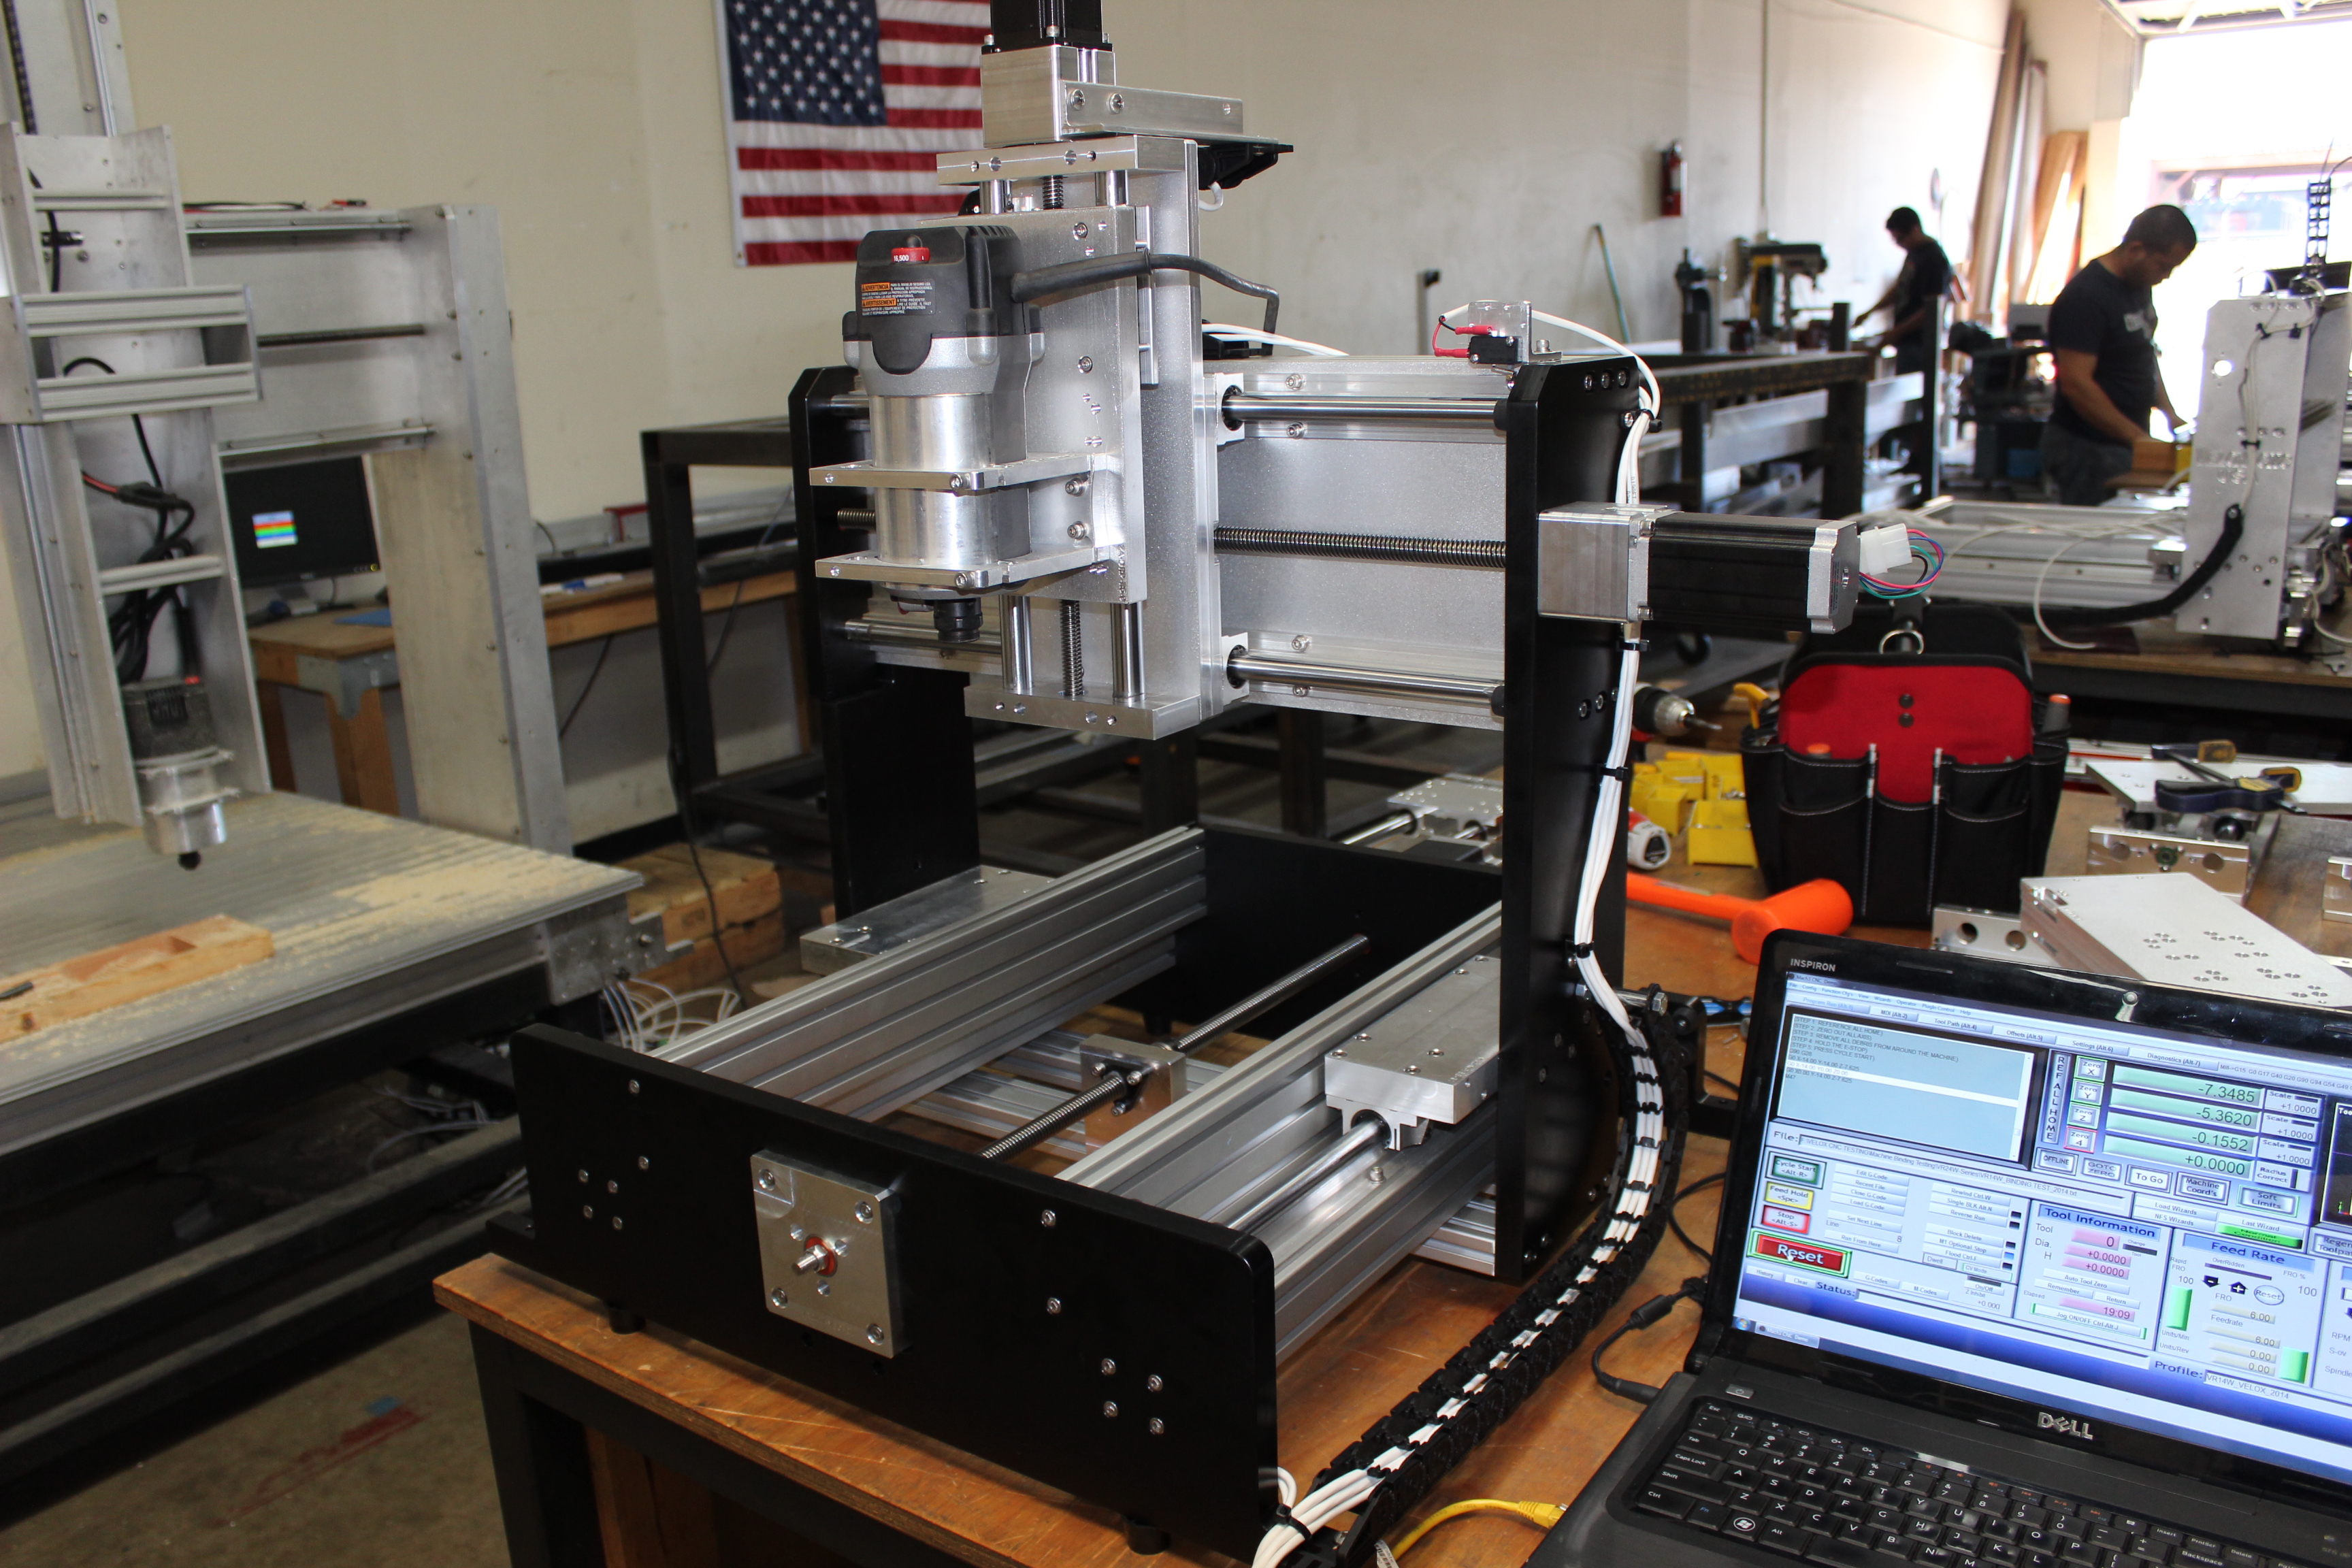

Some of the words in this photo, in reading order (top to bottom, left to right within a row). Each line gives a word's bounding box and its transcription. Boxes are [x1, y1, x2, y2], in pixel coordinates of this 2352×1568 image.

[1790, 958, 1836, 972] INSPIRON
[1802, 984, 1817, 992] Config
[1896, 999, 1916, 1007] Operator
[1803, 997, 1825, 1007] Program
[1892, 1011, 1908, 1019] (Alt-2)
[1816, 1026, 1832, 1034] ZERO
[1818, 1020, 1852, 1030] REFERENCE
[1961, 1022, 1977, 1031] (Alt-4)
[2006, 1030, 2025, 1038] Offsets
[2027, 1032, 2043, 1041] (Alt-5)
[1816, 1033, 1839, 1043] REMOVE
[1874, 1043, 1891, 1051] FROM
[1892, 1045, 1916, 1055] AROUND
[1931, 1052, 1959, 1063] MACHINE)
[2072, 1041, 2095, 1049] Settings
[2096, 1044, 2114, 1054] (Alt-6)
[1814, 1047, 1833, 1055] PRESS
[1833, 1049, 1853, 1058] CYCLE
[1854, 1052, 1876, 1062] START)
[2147, 1053, 2182, 1063] Diagnostics
[2183, 1058, 2201, 1067] (Alt-7)
[2198, 1083, 2255, 1102] -7.3485
[2269, 1091, 2292, 1100] Scale
[2074, 1108, 2093, 1116] Zero
[2281, 1103, 2317, 1115] +1.0000
[2196, 1107, 2253, 1126] -5.3620
[2266, 1115, 2288, 1123] Scale
[1774, 1131, 1798, 1142] File:
[2277, 1128, 2313, 1141] +1.0000
[2192, 1131, 2249, 1152] -0.1552
[2262, 1139, 2285, 1148] Scale
[1893, 1156, 1914, 1166] Binding
[2043, 1154, 2069, 1165] OFFLINE
[2185, 1155, 2245, 1175] +0.0000
[2276, 1154, 2310, 1165] +1.0000
[1775, 1160, 1796, 1169] Cycle
[1798, 1164, 1816, 1173] Start
[2260, 1166, 2287, 1176] Radius
[1781, 1169, 1808, 1178] <Alt-R>
[1868, 1172, 1888, 1180] G-Code
[2087, 1169, 2115, 1178] ZERO
[2257, 1173, 2288, 1183] Correct
[1855, 1179, 1874, 1188] Recent
[2150, 1176, 2163, 1184] Go
[2186, 1177, 2220, 1190] Machine
[1769, 1186, 1788, 1194] Feed
[1791, 1190, 1809, 1198] Hold
[1850, 1189, 1866, 1197] Close
[1950, 1188, 1972, 1198] Rewind
[1974, 1192, 1991, 1200] Ctrl-W
[2186, 1186, 2217, 1197] Coord's
[2258, 1192, 2277, 1201] Soft
[1777, 1195, 1799, 1203] <Spc>
[1947, 1198, 1964, 1207] Single
[2251, 1199, 2281, 1209] Limits
[1950, 1209, 1973, 1218] Reverse
[2155, 1202, 2170, 1211] Load
[2172, 1206, 2197, 1215] Wizards
[1778, 1211, 1795, 1221] Stop
[1771, 1218, 1798, 1228] <Alt-S>
[1870, 1220, 1882, 1228] Line
[2044, 1207, 2071, 1222] Tool
[2076, 1214, 2156, 1238] Information
[2242, 1220, 2255, 1228] Last
[2257, 1222, 2280, 1232] Wizard
[2036, 1224, 2053, 1233] Tool
[1947, 1229, 1963, 1237] Block
[1963, 1233, 1982, 1241] Delete
[1949, 1240, 1972, 1250] Optional
[1974, 1245, 1987, 1254] Stop
[2035, 1238, 2052, 1248] Dia.
[2106, 1237, 2114, 1247] 0
[1777, 1244, 1824, 1264] Reset
[1945, 1250, 1961, 1258] Flood
[2087, 1251, 2126, 1265] +0.0000
[2212, 1242, 2247, 1256] Feed
[2252, 1250, 2285, 1264] Rate
[2212, 1257, 2244, 1269] OverRidden
[2085, 1263, 2125, 1277] +0.0000
[2065, 1274, 2078, 1282] Auto
[2093, 1280, 2107, 1288] Zero
[2178, 1275, 2194, 1285] 100
[1817, 1281, 1855, 1297] Status:
[2047, 1283, 2080, 1294] Remember
[2298, 1285, 2317, 1296] 100
[2023, 1290, 2045, 1299] Elapsed
[2255, 1289, 2281, 1301] Reset
[2106, 1296, 2126, 1305] Return
[2056, 1312, 2068, 1320] Jog
[2069, 1313, 2092, 1324] ON/OFF
[2104, 1307, 2130, 1320] 19:09
[2250, 1311, 2270, 1322] 6.00
[2210, 1314, 2243, 1327] Feedrate
[2161, 1330, 2189, 1341] Units/Min
[2332, 1332, 2351, 1342] RPM
[2255, 1337, 2275, 1346] 6.00
[2159, 1342, 2189, 1354] Units/Rev
[2250, 1350, 2272, 1361] 0.00
[2155, 1361, 2204, 1379] Profile:
[2206, 1373, 2289, 1399] VR14W_VELOX_2014
[2037, 1411, 2093, 1441] DELL
[1674, 1454, 1690, 1462] Caps
[1691, 1458, 1707, 1466] Lock
[1661, 1471, 1678, 1480] Shift
[2157, 1528, 2176, 1537] Insert
[2191, 1538, 2216, 1548] PrntScr
[2182, 1550, 2223, 1566] Backspace
[2231, 1549, 2253, 1558] Delete
